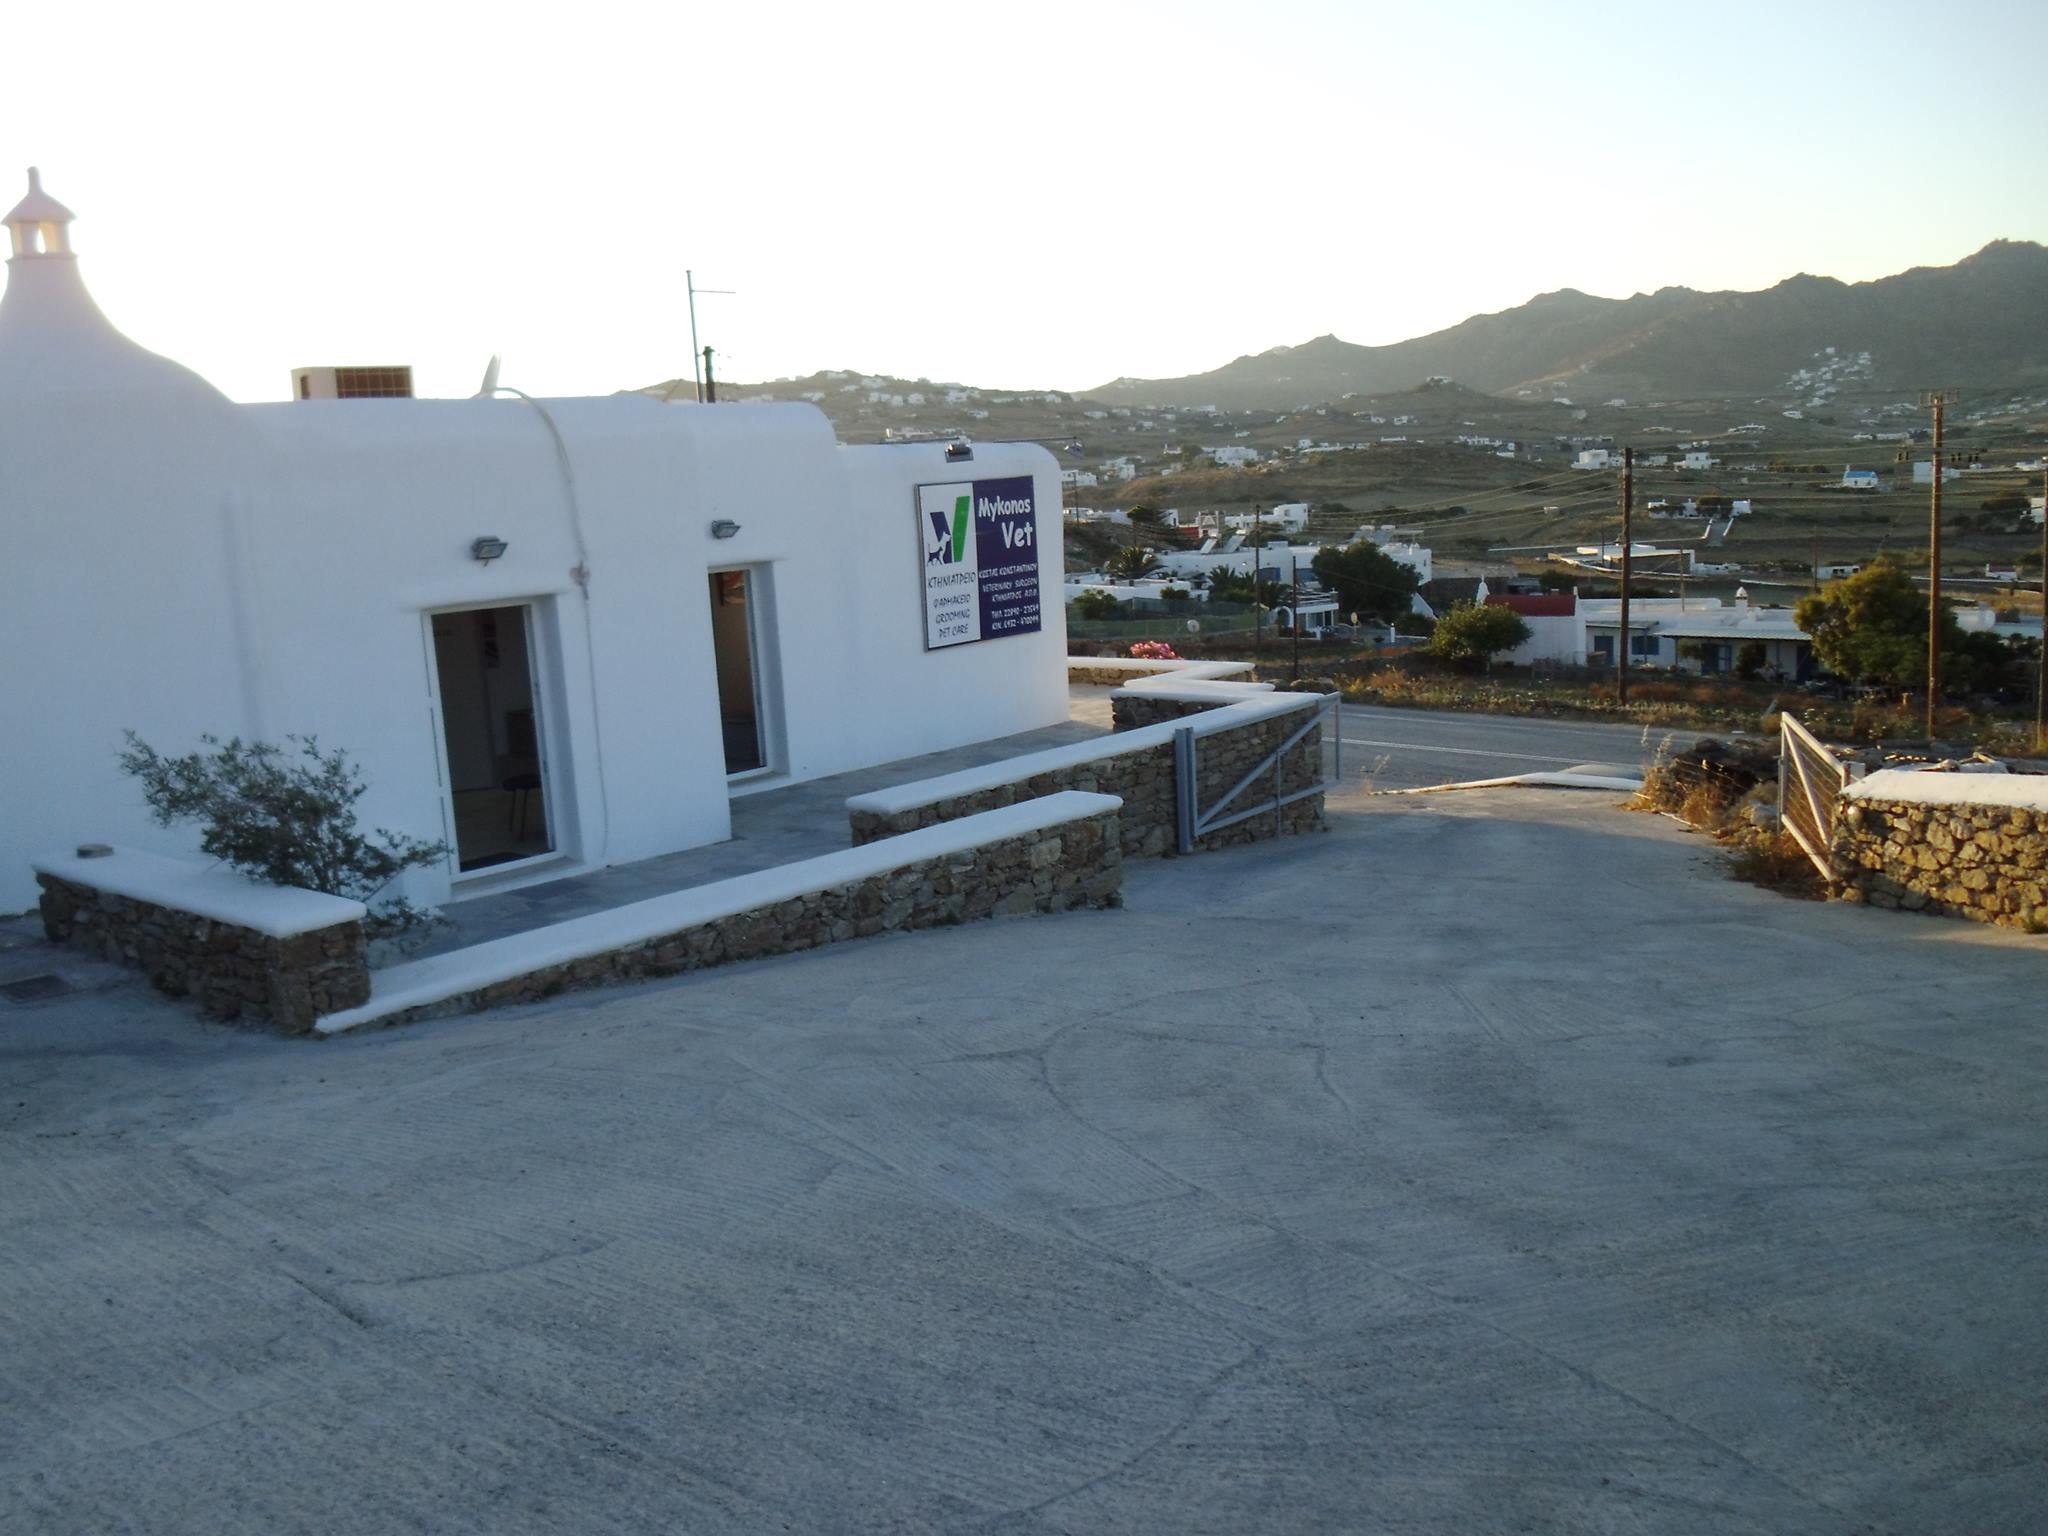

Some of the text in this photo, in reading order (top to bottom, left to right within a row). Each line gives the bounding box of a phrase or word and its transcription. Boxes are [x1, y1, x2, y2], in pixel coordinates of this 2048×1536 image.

[979, 496, 1031, 522] Mykonos
[1002, 521, 1033, 549] Vet
[928, 571, 976, 589] ΚΤΗΝΙΑΤΡΕΙΟ
[939, 623, 969, 639] PET CARE
